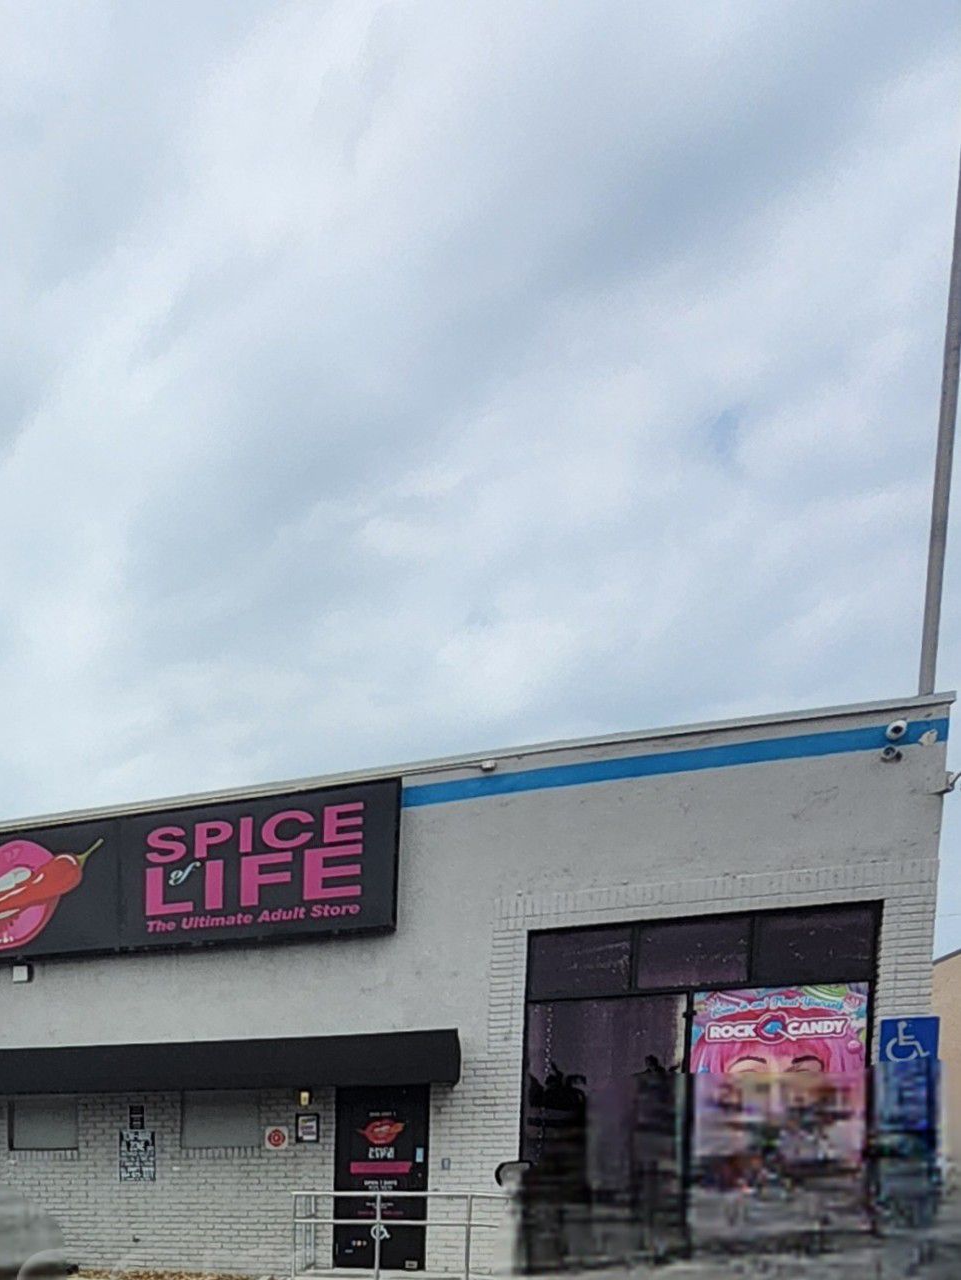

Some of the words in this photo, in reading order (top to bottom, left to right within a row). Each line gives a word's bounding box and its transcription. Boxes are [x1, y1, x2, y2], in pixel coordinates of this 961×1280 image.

[145, 802, 364, 863] SPICE
[145, 843, 363, 916] LIFE
[168, 861, 201, 886] of
[146, 919, 176, 933] The
[181, 911, 253, 931] Ultimate
[257, 906, 306, 924] Adult
[310, 903, 361, 919] Store
[709, 1023, 758, 1039] ROCK
[788, 1019, 846, 1036] CANDY
